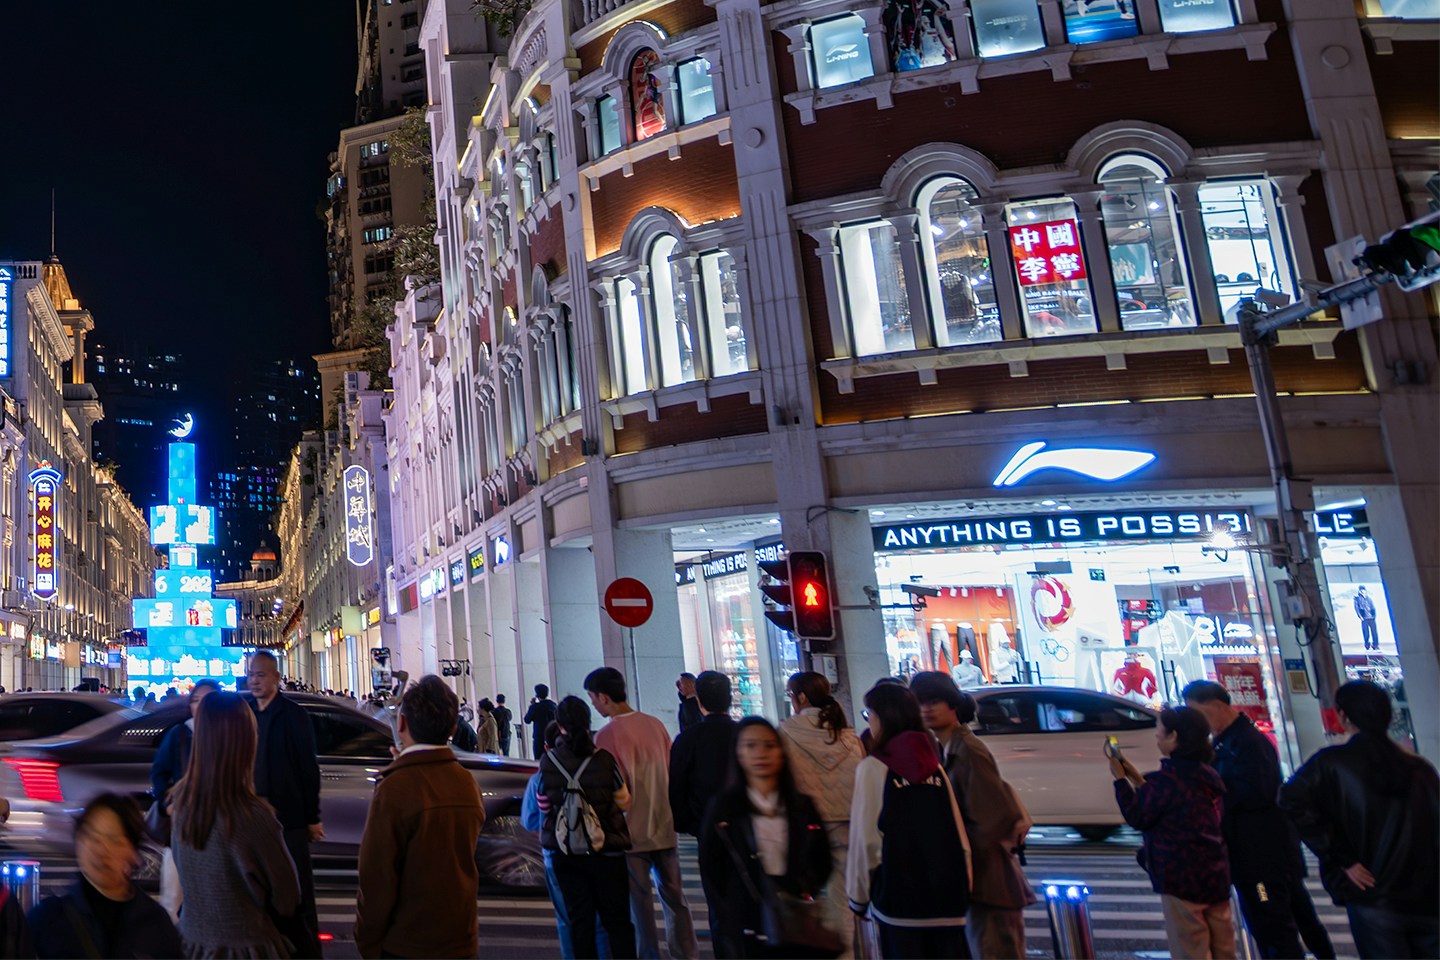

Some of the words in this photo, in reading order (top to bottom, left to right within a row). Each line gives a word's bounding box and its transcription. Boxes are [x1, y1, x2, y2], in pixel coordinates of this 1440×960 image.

[1013, 222, 1075, 252] 中國
[37, 496, 52, 569] 开心麻花
[884, 520, 1032, 547] ANYTHING
[1047, 518, 1081, 538] IS
